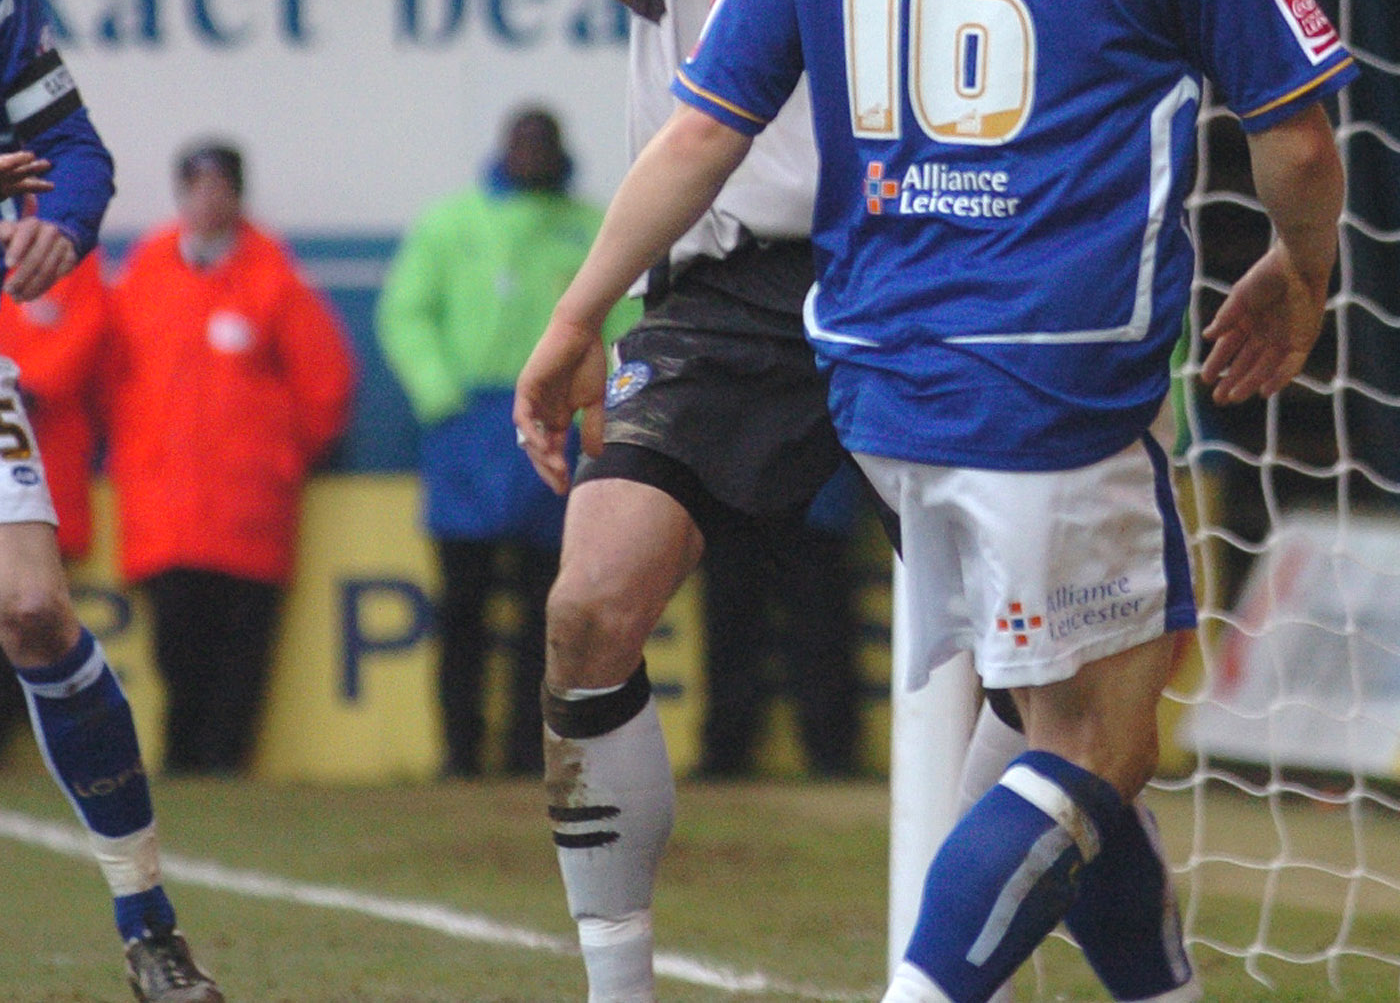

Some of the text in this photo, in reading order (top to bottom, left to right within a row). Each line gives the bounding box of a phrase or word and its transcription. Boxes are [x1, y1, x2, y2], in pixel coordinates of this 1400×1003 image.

[901, 162, 1009, 193] Alliance
[899, 190, 1020, 218] Leicester
[1047, 575, 1131, 613] Alliance
